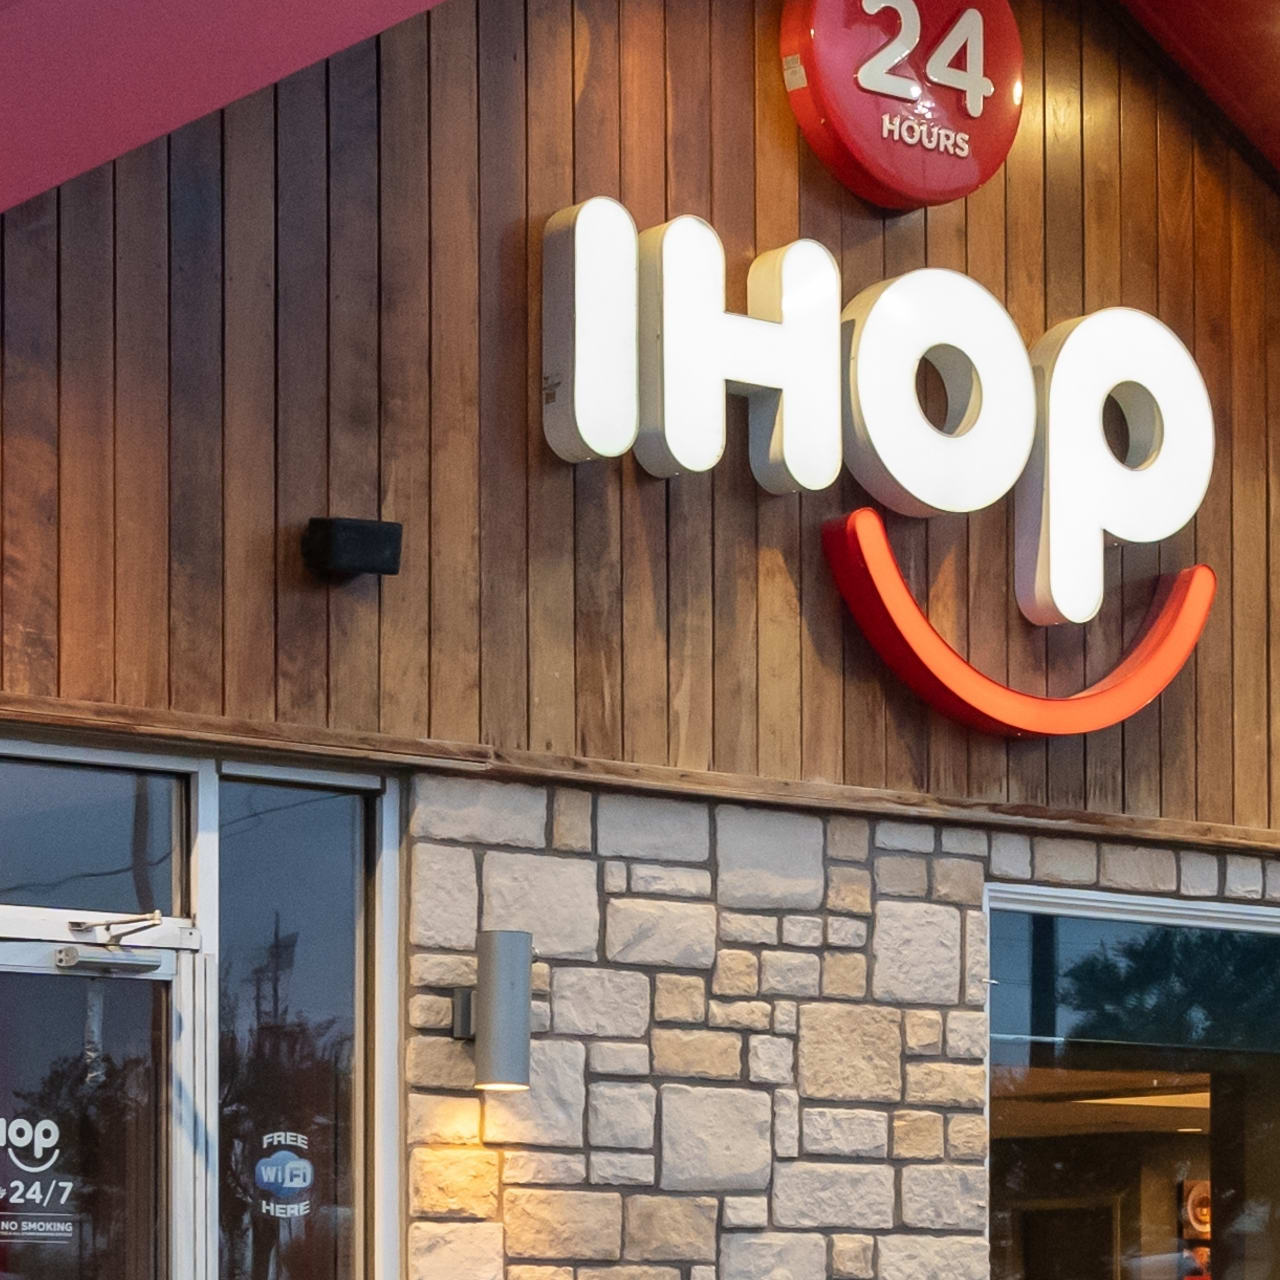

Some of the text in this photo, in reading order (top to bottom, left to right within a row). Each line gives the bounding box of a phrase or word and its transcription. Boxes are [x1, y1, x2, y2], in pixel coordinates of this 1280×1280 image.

[881, 112, 970, 158] HOURS
[262, 1131, 309, 1149] FREE
[9, 1180, 74, 1207] 24/7
[261, 1200, 311, 1218] HERE
[1, 1220, 18, 1231] NO
[21, 1221, 73, 1232] SMOKING
